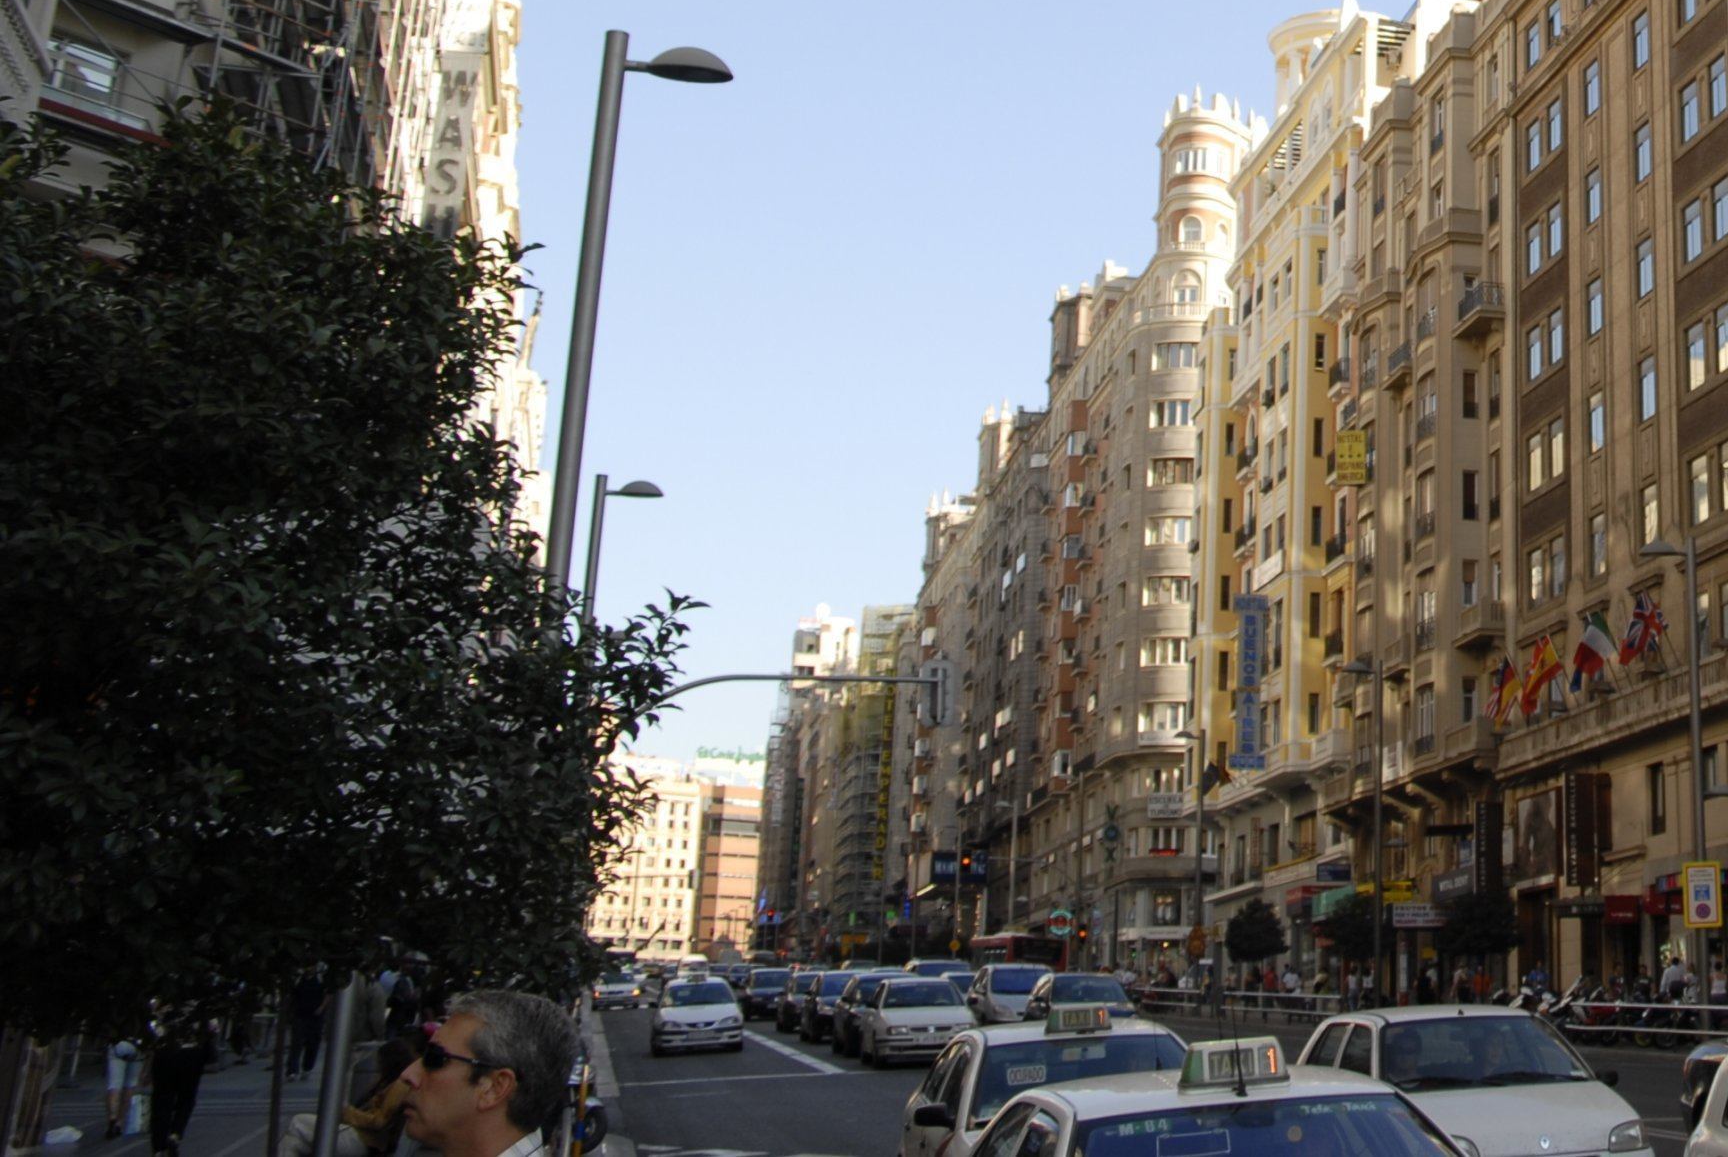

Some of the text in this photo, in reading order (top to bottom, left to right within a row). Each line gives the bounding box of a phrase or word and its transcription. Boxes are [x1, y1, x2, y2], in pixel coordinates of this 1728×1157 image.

[1063, 1009, 1105, 1026] TAXI 1
[1266, 1046, 1277, 1074] 1
